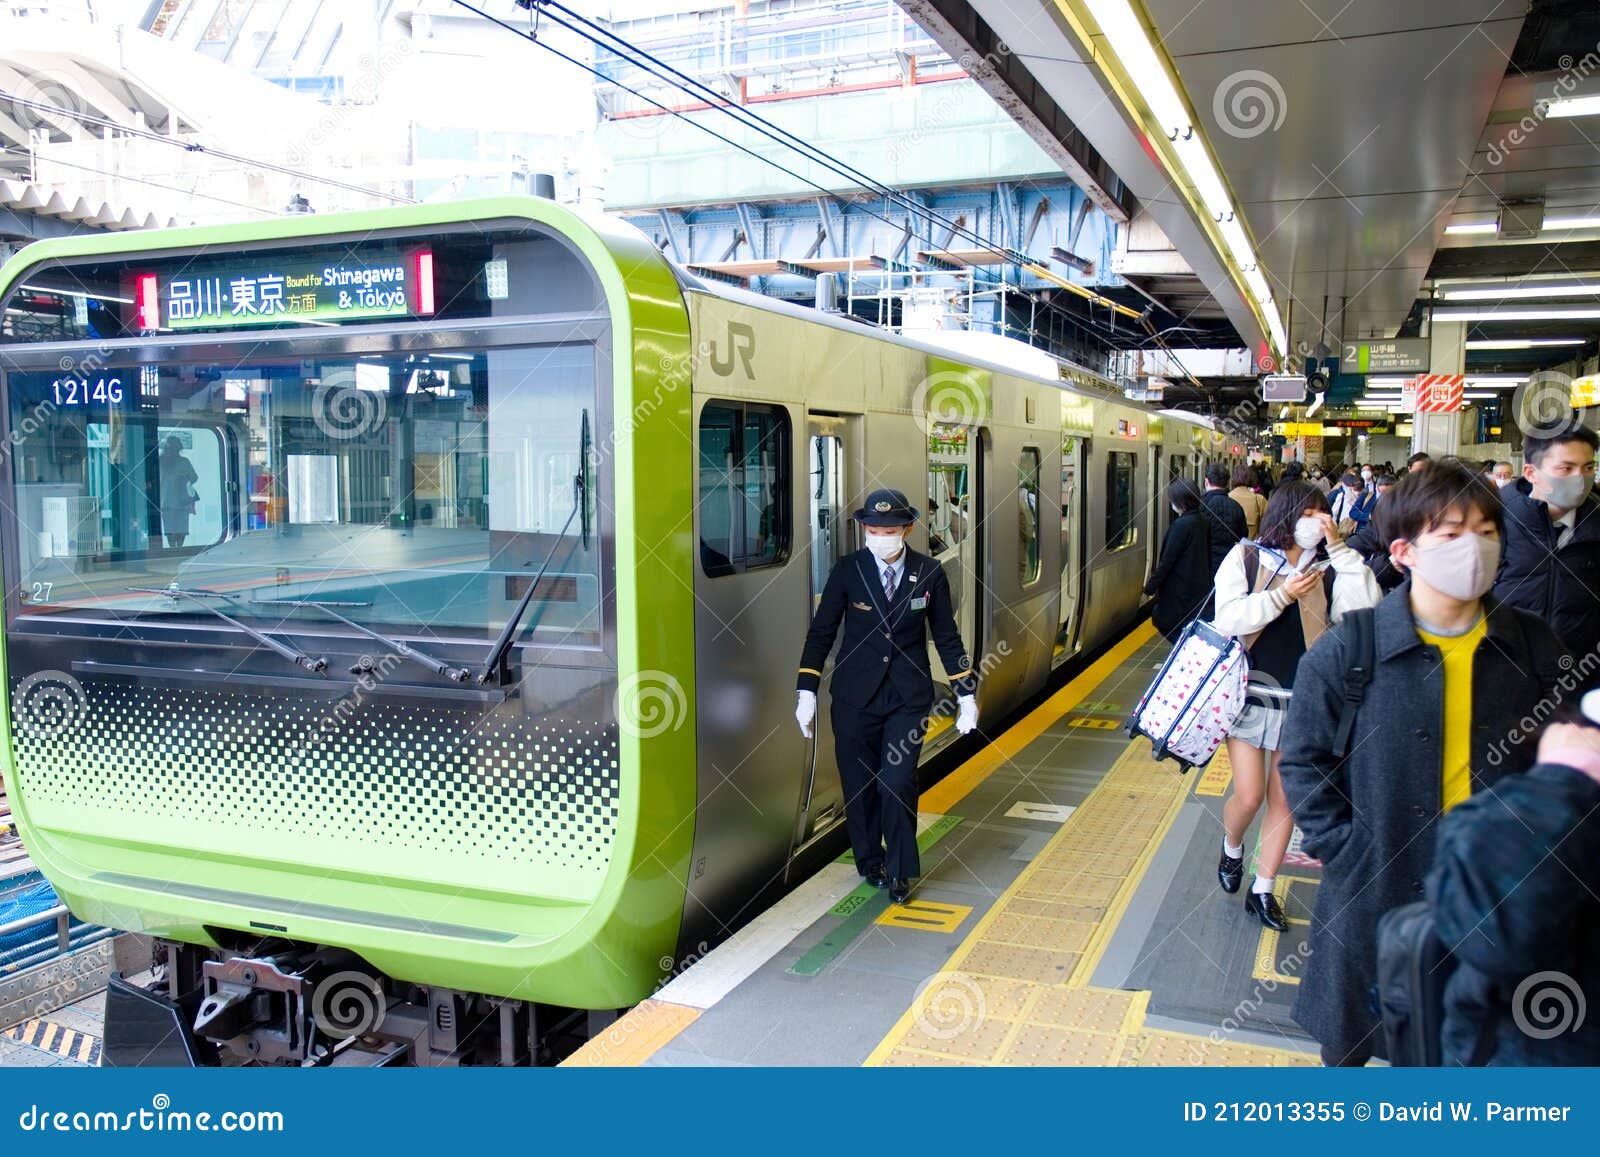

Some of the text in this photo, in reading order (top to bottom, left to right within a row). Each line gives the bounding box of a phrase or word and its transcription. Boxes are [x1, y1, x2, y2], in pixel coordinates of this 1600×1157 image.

[286, 266, 405, 289] Bound for Shinagawa
[168, 273, 286, 320] 品川・東京
[286, 293, 318, 314] 方面
[338, 286, 406, 312] & Tōkyō
[709, 320, 757, 381] JR
[1344, 345, 1357, 363] 2
[52, 378, 123, 405] 1214G
[32, 582, 53, 603] 27
